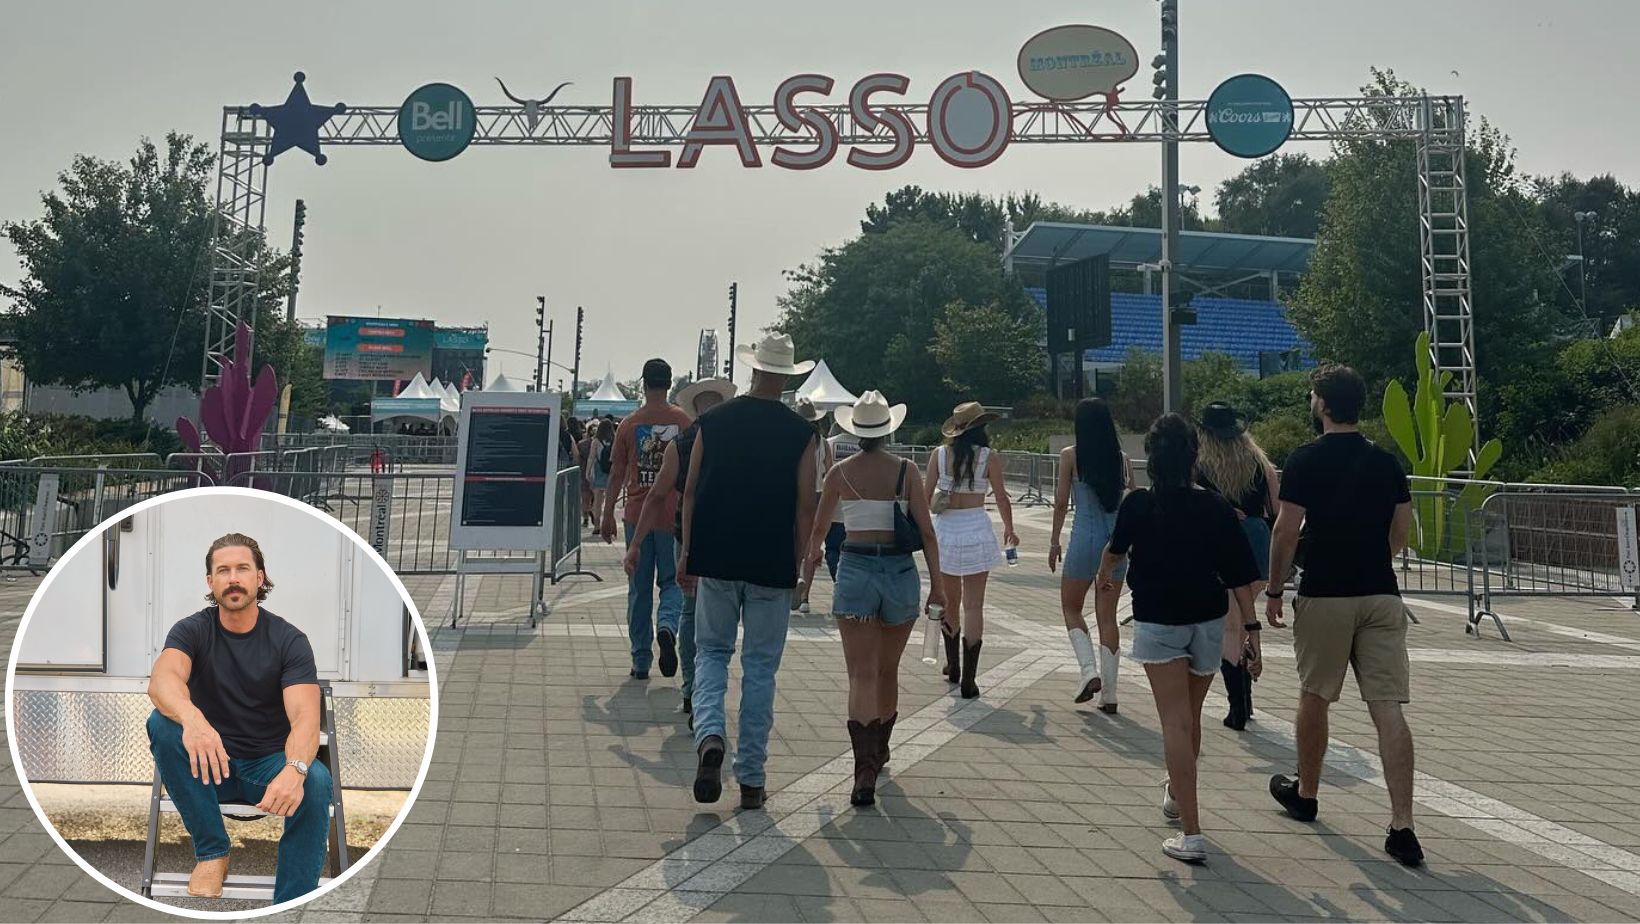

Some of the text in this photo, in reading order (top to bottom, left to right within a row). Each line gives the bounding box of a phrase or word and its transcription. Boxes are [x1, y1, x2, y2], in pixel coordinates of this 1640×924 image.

[1030, 50, 1127, 71] MONTRÉAL
[412, 100, 463, 131] Bell
[609, 70, 1013, 171] LASSO
[1217, 107, 1262, 123] Coors
